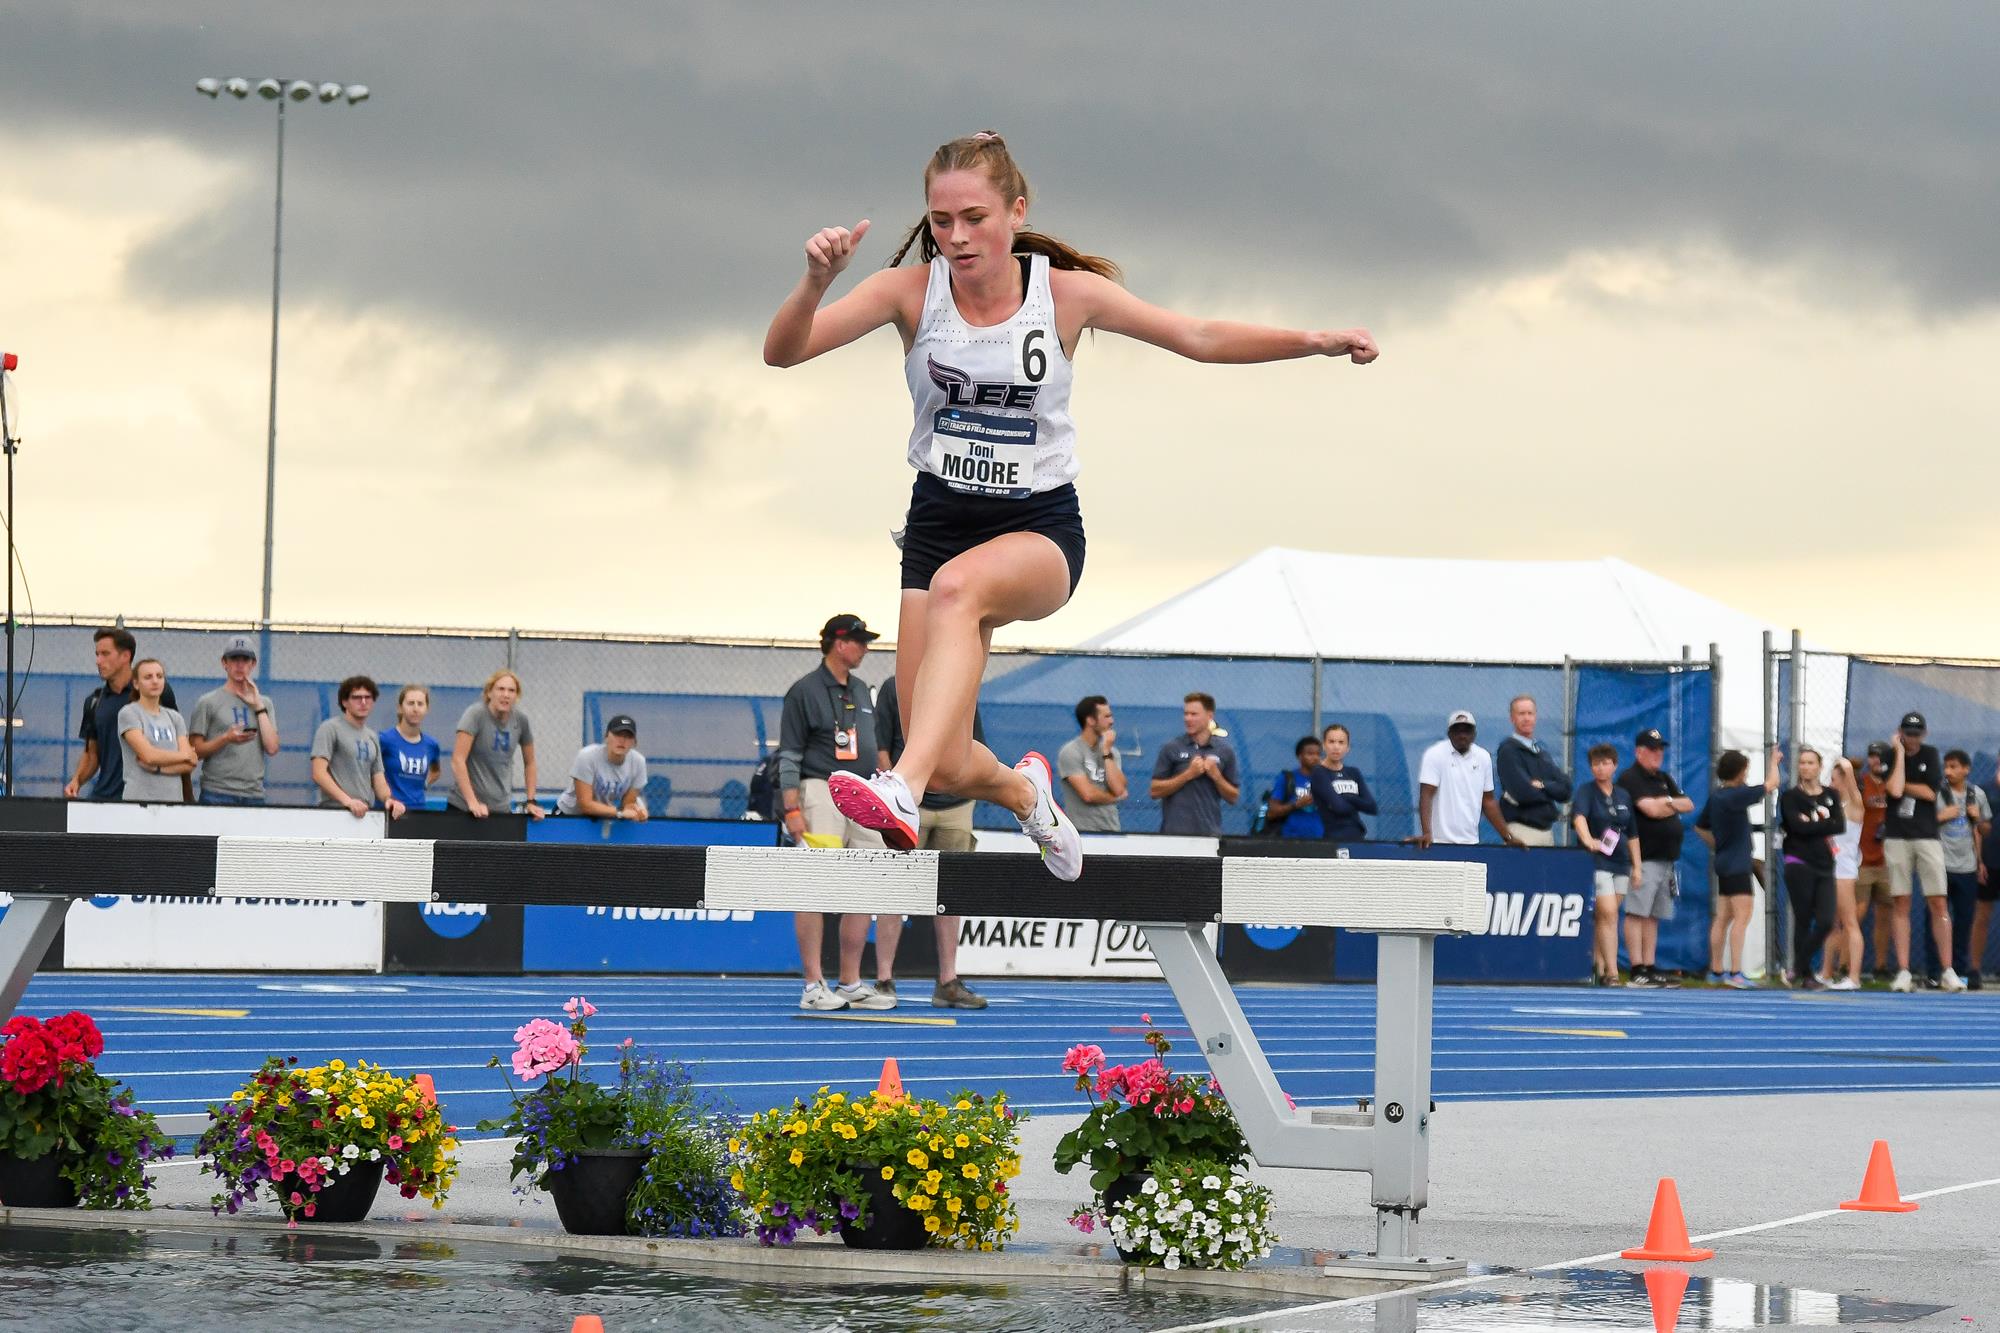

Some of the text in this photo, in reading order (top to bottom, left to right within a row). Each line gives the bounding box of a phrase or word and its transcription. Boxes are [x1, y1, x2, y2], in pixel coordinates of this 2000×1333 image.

[1022, 329, 1047, 383] 6
[946, 382, 1042, 411] LEE
[949, 422, 966, 431] TRACK
[971, 425, 986, 434] FIELD
[985, 428, 1031, 438] CHAMPIONSHIPS
[969, 442, 994, 458] Toni
[942, 453, 1019, 485] MOORE
[408, 757, 421, 775] H
[958, 919, 1047, 947] MAKE
[1055, 921, 1084, 948] IT
[1389, 1105, 1402, 1117] 30
